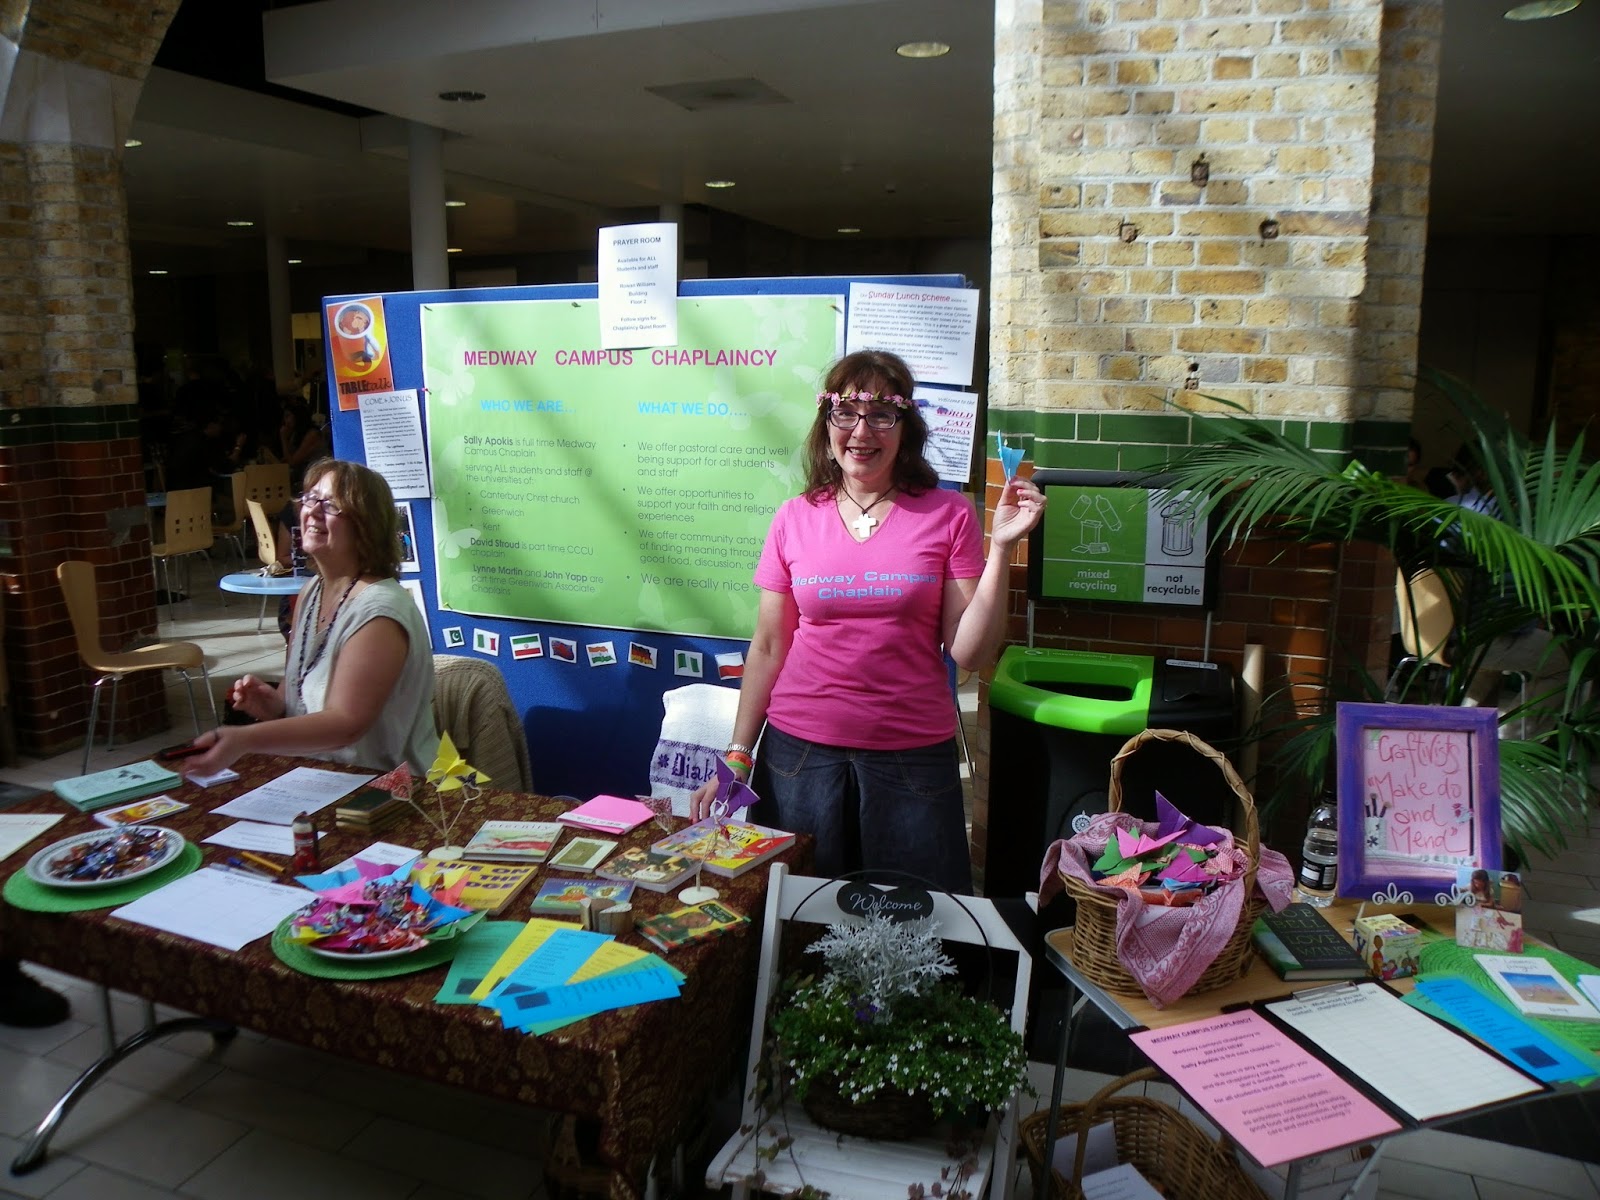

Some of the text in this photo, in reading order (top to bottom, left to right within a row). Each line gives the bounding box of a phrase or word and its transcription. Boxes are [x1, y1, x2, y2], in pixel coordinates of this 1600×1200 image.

[868, 291, 950, 302] Sunday Lunch Scheme
[464, 349, 777, 366] MEDWAY CAMPUS CHAPLAINCY
[480, 399, 511, 413] WHO
[514, 400, 533, 413] WE
[638, 401, 677, 414] WHAT
[681, 402, 704, 415] WE
[464, 435, 596, 450] Sally Apokis is full time Medway
[638, 442, 788, 456] We offer pastoral care and well
[464, 448, 536, 458] Campus Chaplain
[638, 455, 775, 468] being support for all students
[465, 463, 492, 474] serving
[509, 465, 543, 475] students
[545, 466, 562, 476] and
[563, 466, 582, 477] staff
[584, 468, 593, 477] @
[637, 468, 678, 477] and staff
[466, 474, 478, 482] the
[481, 475, 522, 484] universities
[480, 490, 580, 504] Canterbury Christ church
[637, 486, 754, 502] We offer opportunities to
[482, 506, 524, 517] Greenwich
[638, 499, 780, 516] support your faith and religiou
[638, 512, 695, 523] experiences
[482, 522, 500, 531] Kent
[639, 529, 653, 539] We
[657, 530, 677, 540] offer
[680, 532, 733, 545] community
[736, 536, 757, 545] and
[471, 538, 594, 556] David Stroud is part time CCCU
[471, 549, 505, 559] chaplain
[640, 542, 761, 558] of finding meaning throug
[640, 555, 664, 564] good
[695, 557, 744, 570] discussion,
[473, 564, 603, 584] Lynne Martin and John Yapp are
[864, 571, 937, 584] Campus
[1077, 569, 1110, 579] mixed
[1166, 574, 1183, 583] not
[509, 578, 552, 589] Greenwich
[555, 582, 596, 593] Associate
[641, 573, 749, 591] We are really nice
[1069, 580, 1117, 592] recycling
[472, 584, 511, 596] Chaplains
[818, 586, 903, 600] Chaplain
[1147, 585, 1201, 596] recyclable
[1438, 777, 1462, 798] do
[1394, 804, 1447, 828] and
[465, 881, 515, 889] DGE
[850, 893, 923, 911] Welcome
[1265, 909, 1314, 918] ROB
[1271, 920, 1326, 928] BELL
[1287, 935, 1340, 944] LOVE
[1296, 946, 1351, 956] WINS
[1151, 1017, 1252, 1044] MEDWAY CAMPUS CHAPLAINCY
